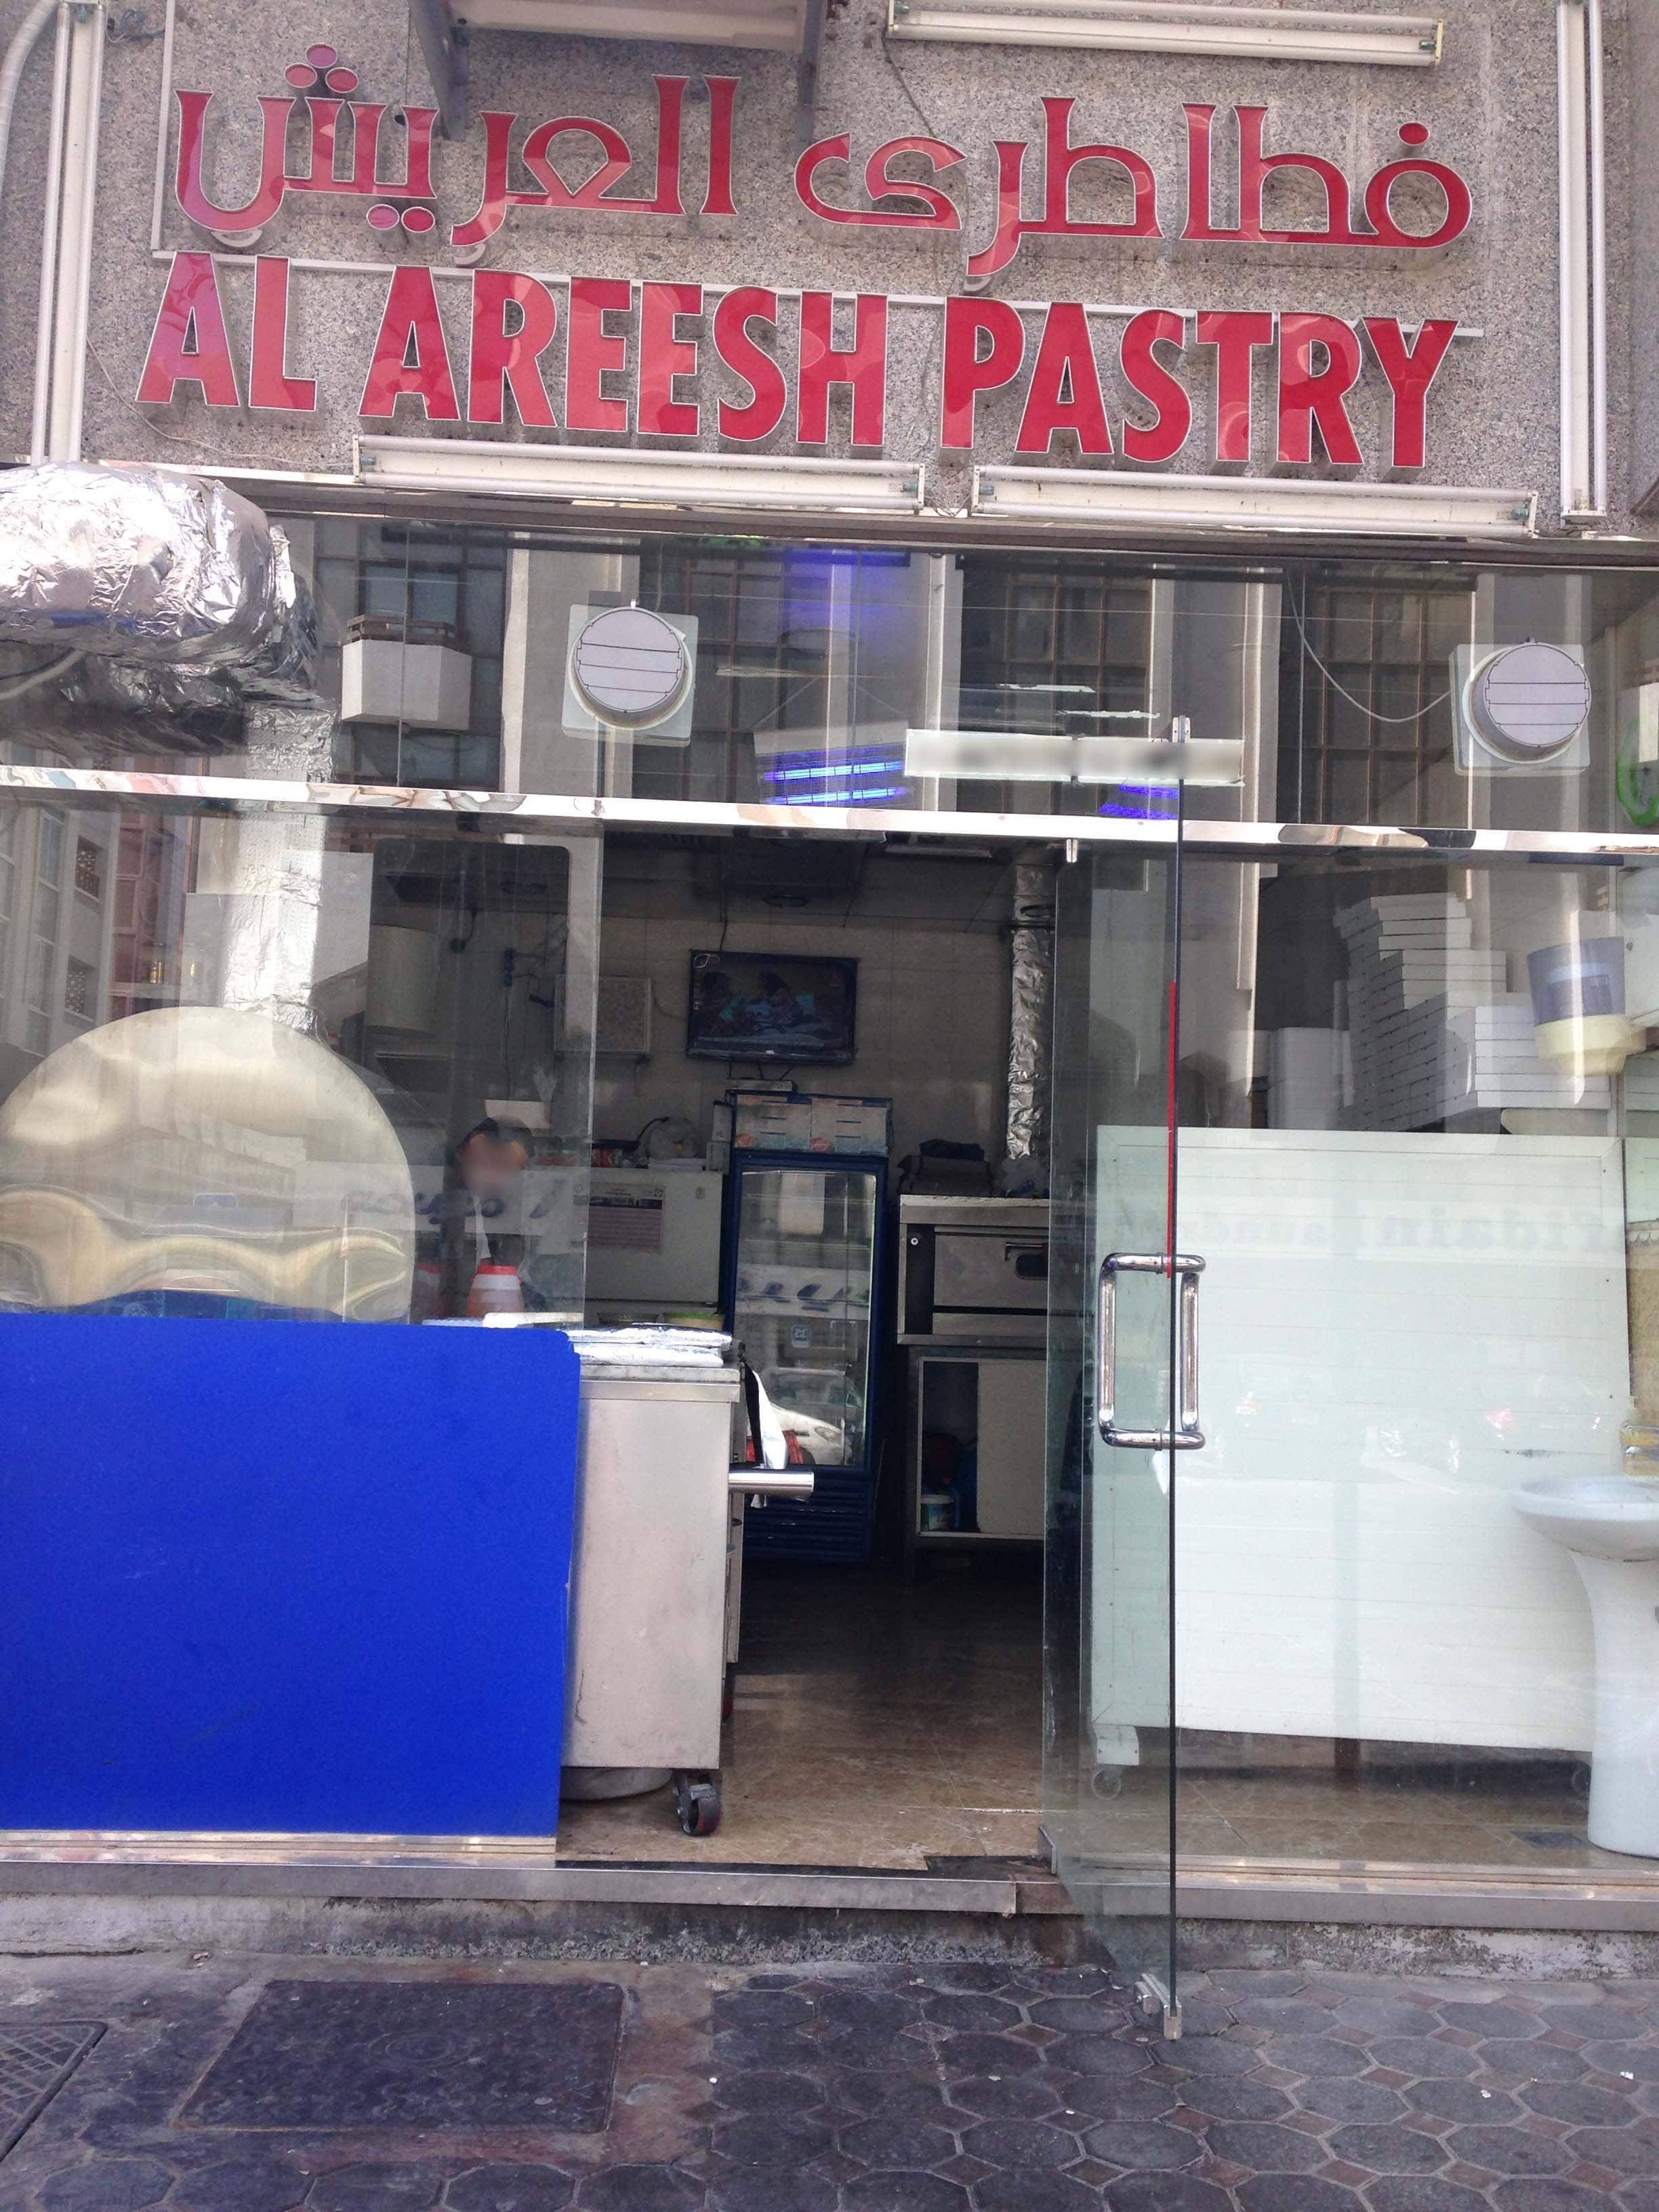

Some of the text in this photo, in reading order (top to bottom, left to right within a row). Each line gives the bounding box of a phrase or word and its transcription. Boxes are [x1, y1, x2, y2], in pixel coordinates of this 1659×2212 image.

[175, 43, 741, 247] العريش
[135, 251, 1460, 469] AL AREESH PASTRY
